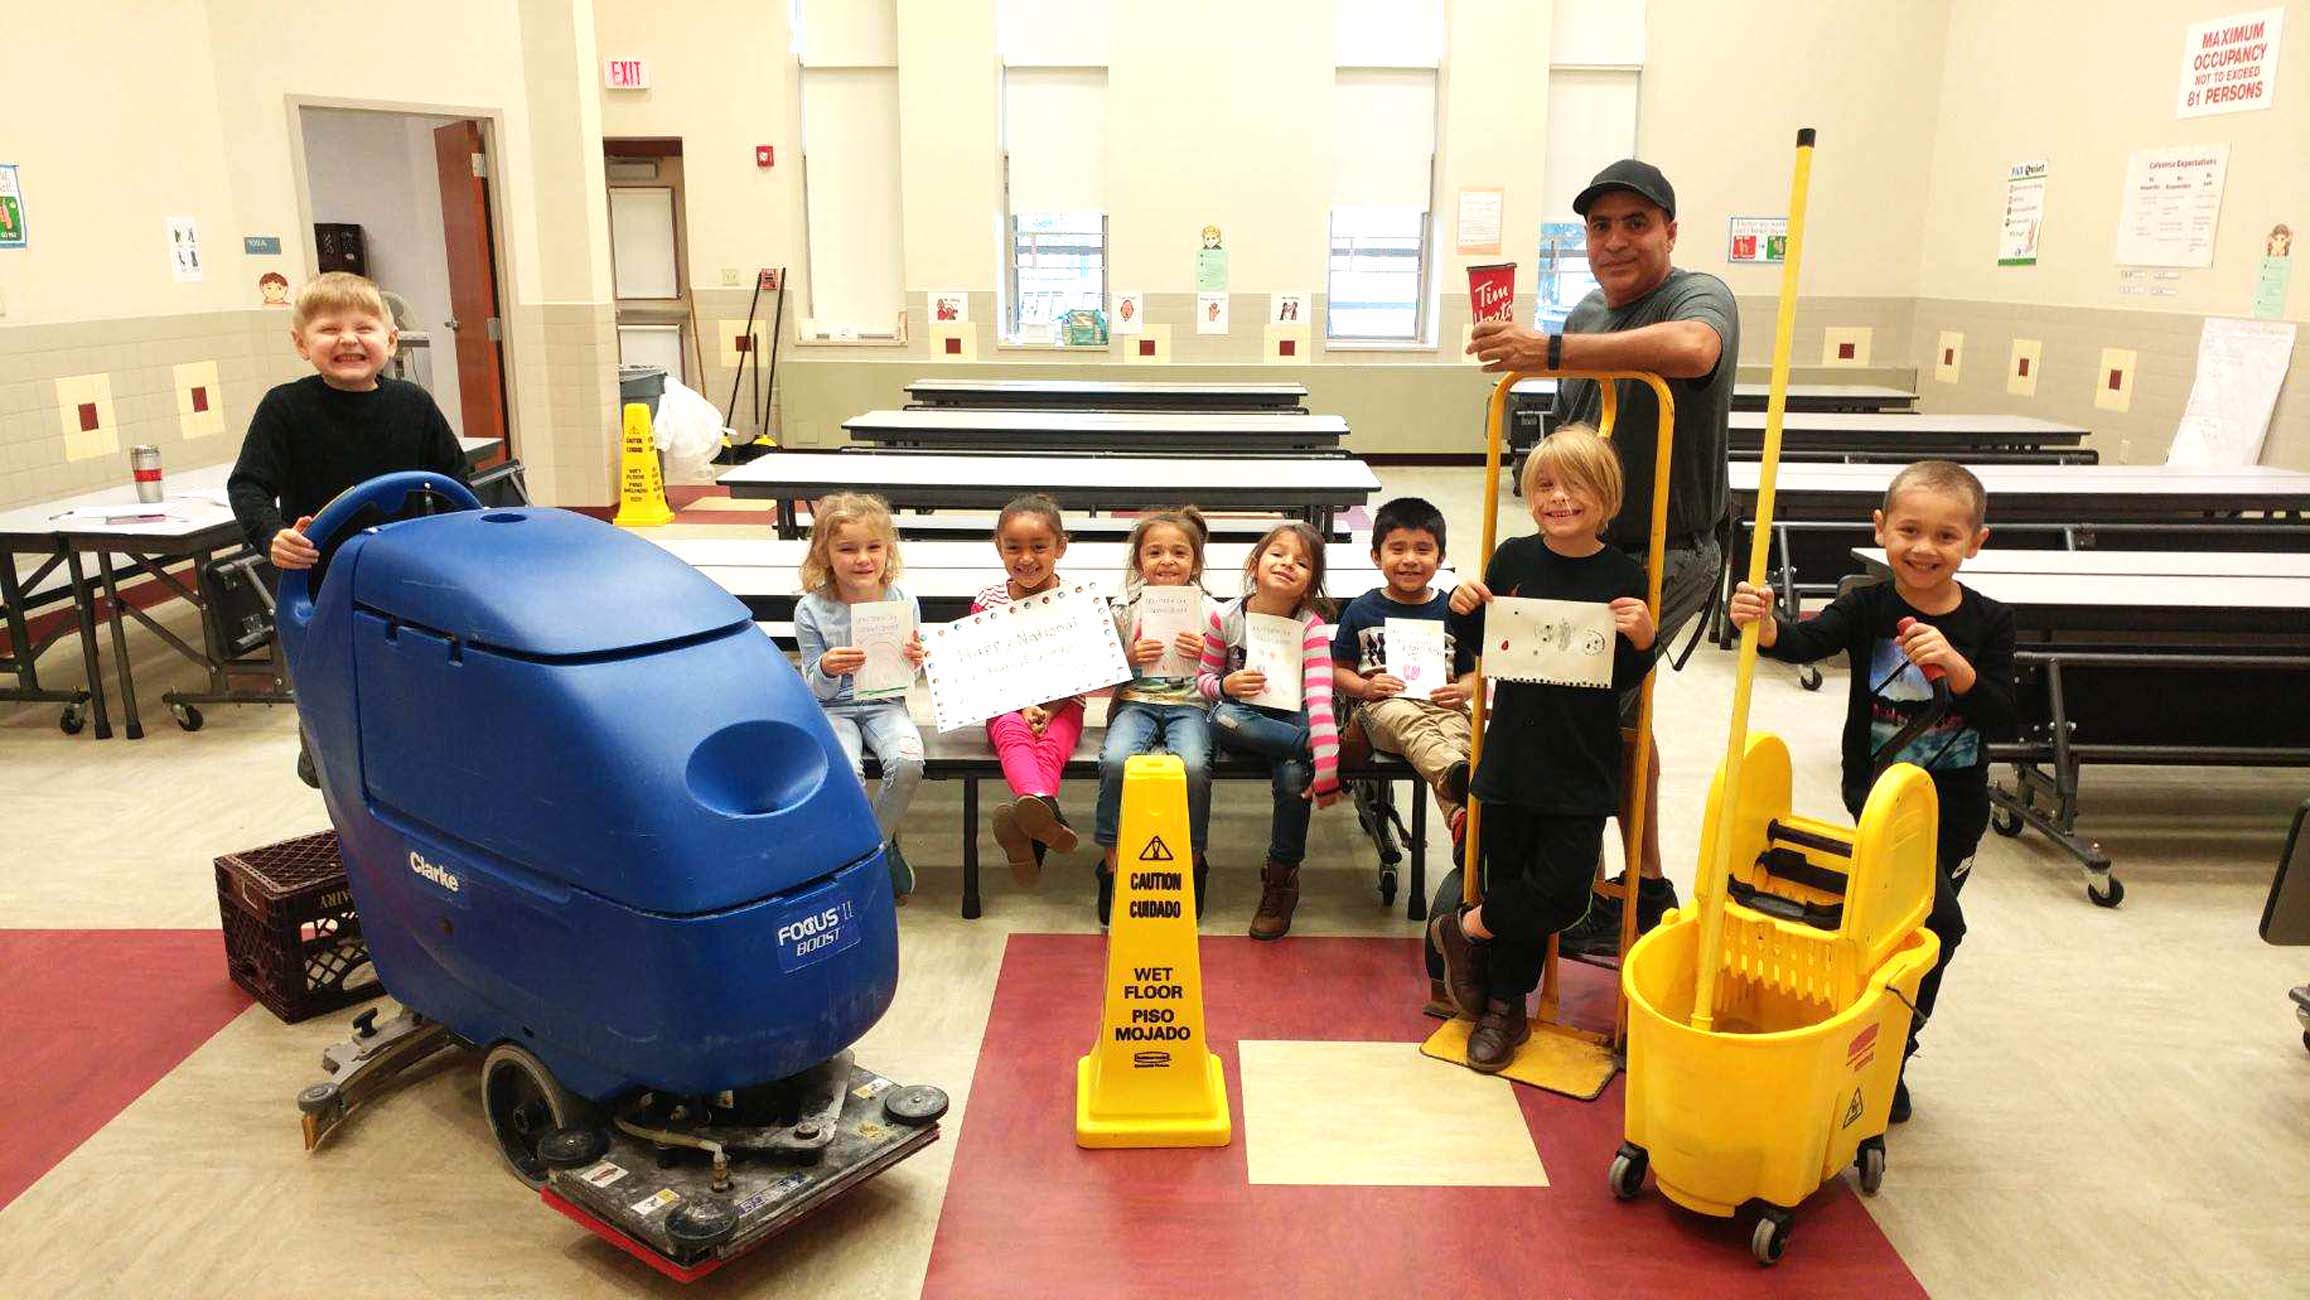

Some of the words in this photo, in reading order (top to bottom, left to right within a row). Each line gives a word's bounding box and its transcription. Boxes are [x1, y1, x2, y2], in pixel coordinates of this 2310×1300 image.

[2202, 21, 2265, 49] MAXIMUM
[2194, 42, 2267, 70] OCCUPANCY
[611, 60, 640, 86] EXIT
[2195, 73, 2211, 86] NOT
[2214, 71, 2224, 82] TO
[2226, 65, 2260, 81] EXCEED
[2187, 90, 2201, 107] 81
[2205, 81, 2263, 104] PERSONS
[1474, 280, 1508, 308] Tim
[410, 852, 460, 892] Clarke
[1130, 872, 1182, 891] CAUTION
[1129, 901, 1181, 918] CUIDADO
[778, 907, 839, 946] FOCUS
[796, 928, 841, 956] BOOST
[1134, 968, 1173, 981] WET
[1124, 985, 1182, 999] FLOOR
[1132, 1009, 1174, 1024] PISO
[1115, 1027, 1191, 1041] MOJADO
